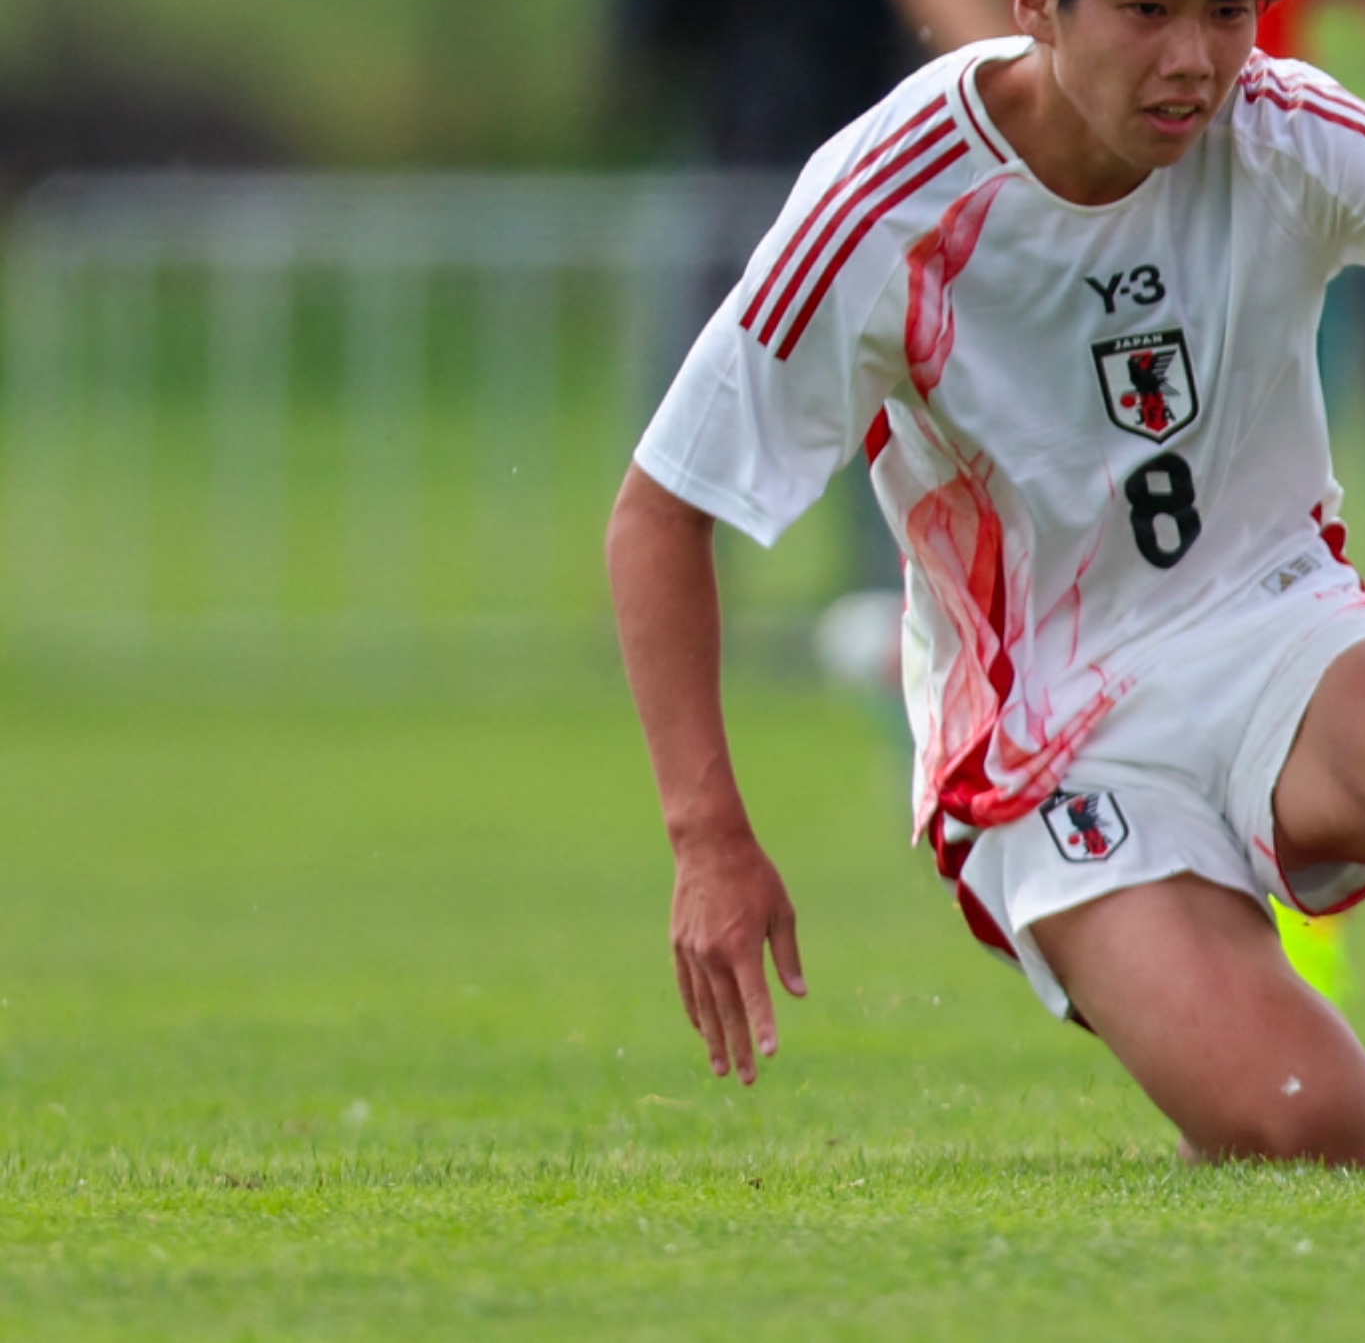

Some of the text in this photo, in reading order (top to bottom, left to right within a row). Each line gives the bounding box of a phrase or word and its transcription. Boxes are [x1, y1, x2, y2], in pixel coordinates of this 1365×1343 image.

[1084, 264, 1166, 315] Y-3
[1114, 333, 1163, 351] JAPAN
[1124, 451, 1202, 569] 8
